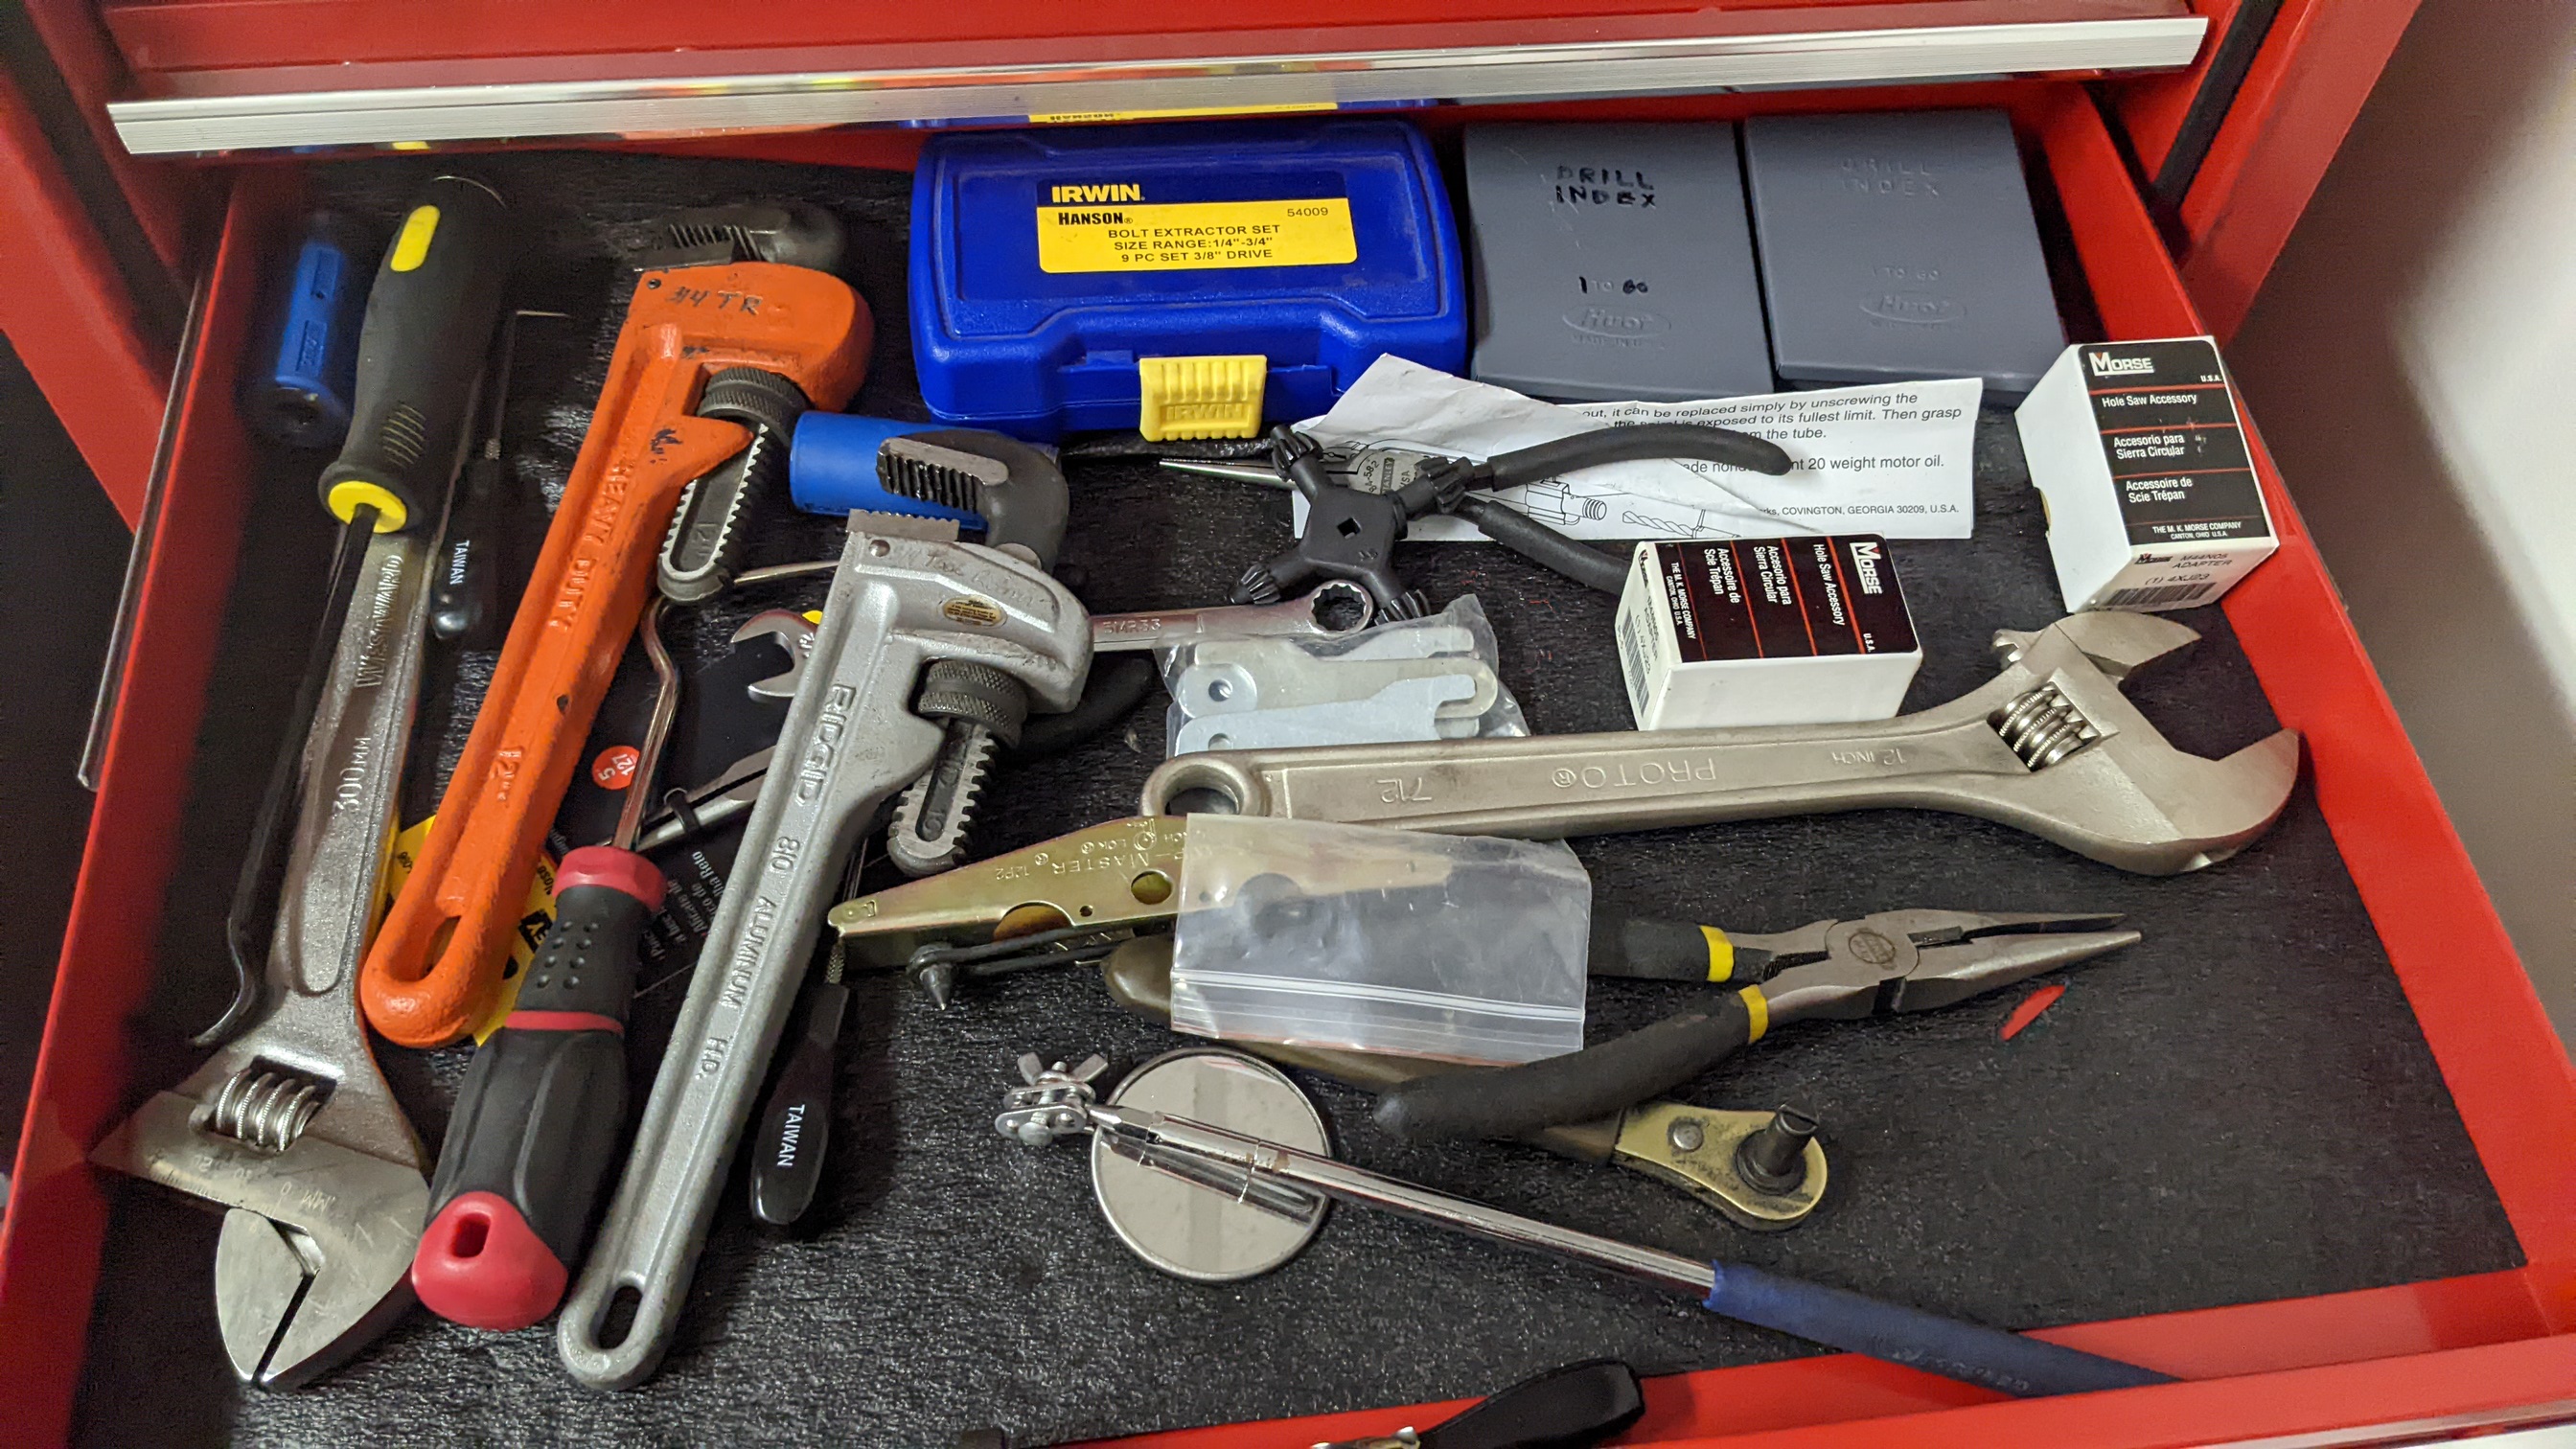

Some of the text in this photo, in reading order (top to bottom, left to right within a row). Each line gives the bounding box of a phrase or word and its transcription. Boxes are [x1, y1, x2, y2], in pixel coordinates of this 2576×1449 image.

[1556, 165, 1654, 191] DRILL
[1051, 183, 1141, 203] IRWIN
[1555, 185, 1656, 208] INDEX
[1287, 207, 1329, 218] 54009
[1108, 224, 1280, 239] BOLT EXTRACTOR SET
[1115, 241, 1148, 251] SIZE
[1121, 254, 1130, 263] 9
[1135, 253, 1155, 263] PC
[1160, 251, 1189, 262] SET
[1227, 249, 1274, 260] DRIVE
[2088, 351, 2155, 376] MORSE
[1166, 402, 1245, 421] IRWIN
[1612, 407, 1621, 417] it
[1623, 407, 1649, 417] can
[1653, 409, 1671, 418] be
[1675, 404, 1737, 418] replaced
[1740, 402, 1786, 413] simply
[1789, 400, 1807, 410] by
[1810, 394, 1891, 408] unscrewing
[1896, 393, 1919, 403] the
[2102, 393, 2197, 408] Hole Saw Accessory
[1696, 416, 1757, 428] exposed
[1760, 415, 1774, 425] to
[1778, 414, 1794, 424] its
[1798, 410, 1840, 424] fullest
[1844, 409, 1876, 422] limit.
[1882, 408, 1918, 420] Then
[1920, 407, 1963, 422] grasp
[1766, 428, 1788, 440] the
[1792, 427, 1828, 439] tube.
[2113, 434, 2186, 448] Accesorio para
[1682, 460, 1708, 473] ade
[1807, 457, 1826, 470] 20
[1829, 456, 1876, 472] weight
[1880, 456, 1921, 469] motor
[1924, 454, 1944, 468] oil.
[2116, 446, 2185, 460] Sierra Circular
[1363, 460, 1380, 493] 84-582
[2126, 476, 2194, 492] Accessoire de
[2128, 489, 2186, 504] Scie Trépan
[1782, 506, 1846, 516] COVINGTON,
[1847, 505, 1895, 515] GEORGIA
[1930, 504, 1960, 514] U.S.A.
[2152, 521, 2242, 534] THE M. K. MORSE COMPANY
[449, 540, 472, 586] TAIWAN
[1670, 562, 1681, 573] THE
[1704, 548, 1724, 595] Scie Trépan
[1849, 541, 1883, 594] MORSE
[1717, 548, 1741, 604] Accessoire de
[1753, 546, 1778, 604] Sierra Circular
[1766, 545, 1792, 606] Accesorio para
[1812, 543, 1846, 627] Hole Saw Accessory
[1677, 587, 1689, 610] MORSE
[1682, 610, 1696, 640] COMPANY
[795, 683, 857, 807] RIDGID
[611, 753, 636, 777] 127
[1831, 748, 1907, 766] 12 INCH
[598, 768, 616, 781] 5
[1376, 777, 1433, 803] 712
[692, 851, 714, 880] Reto
[770, 836, 801, 872] 810
[720, 895, 778, 1009] ALUMINUM
[776, 1103, 806, 1167] TAIWAN
